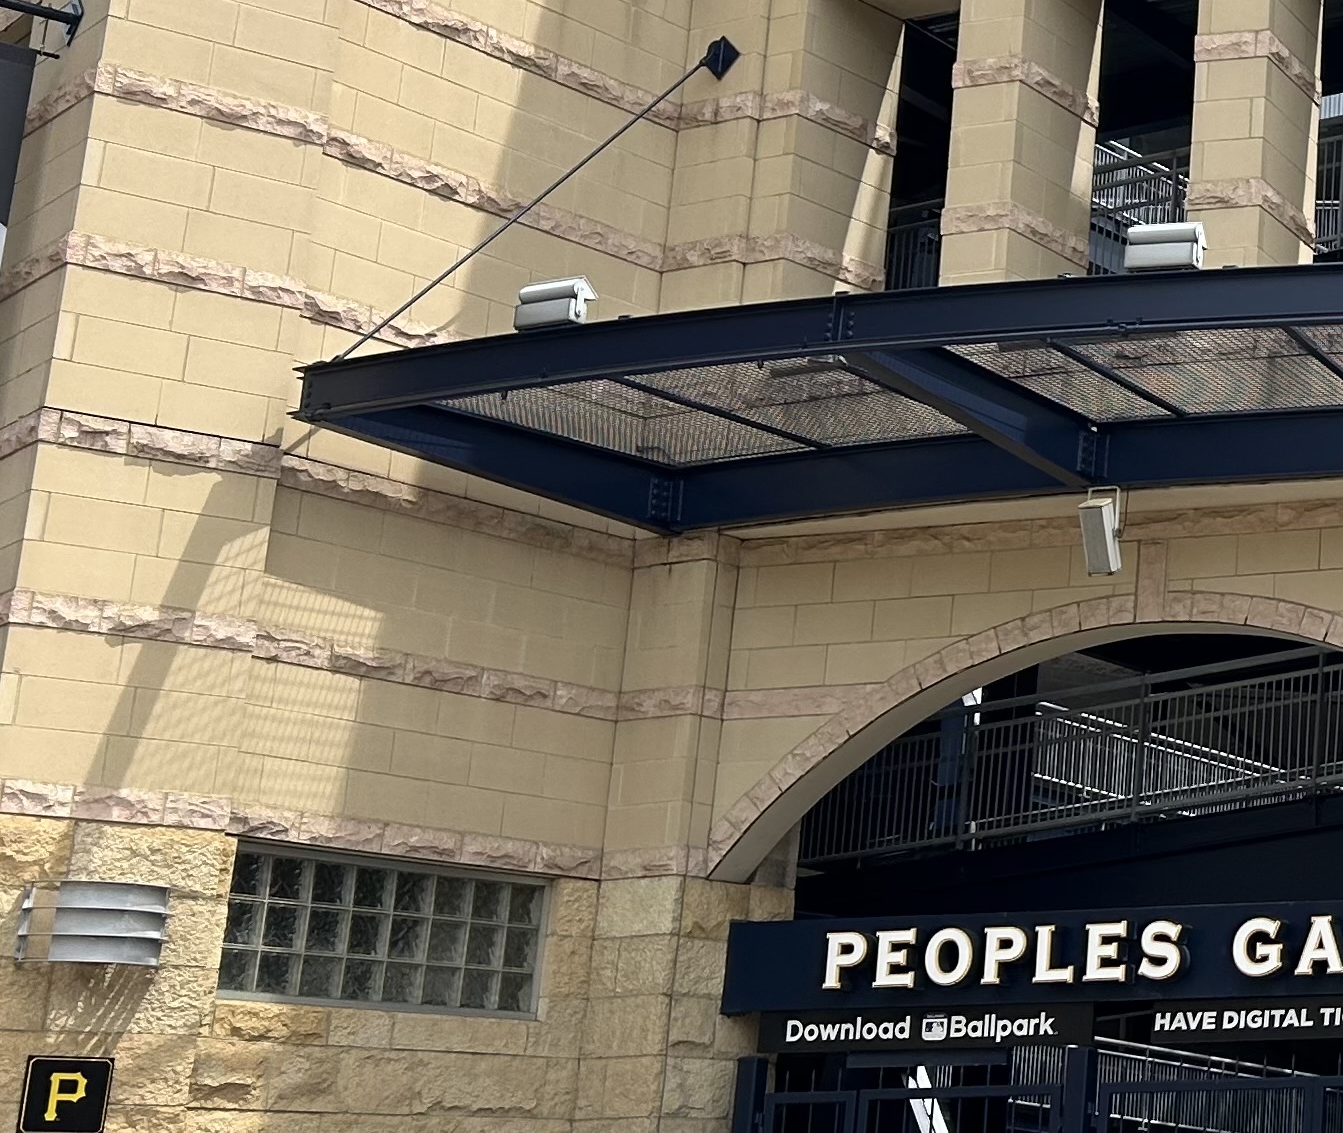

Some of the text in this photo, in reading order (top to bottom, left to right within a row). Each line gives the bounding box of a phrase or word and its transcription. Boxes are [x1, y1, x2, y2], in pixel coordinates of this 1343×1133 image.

[821, 919, 1184, 990] PEOPLES
[785, 1012, 1056, 1043] Download Ballpark
[1154, 1010, 1217, 1031] HAVE
[1222, 1007, 1314, 1030] DIGITAL
[44, 1072, 88, 1121] P
